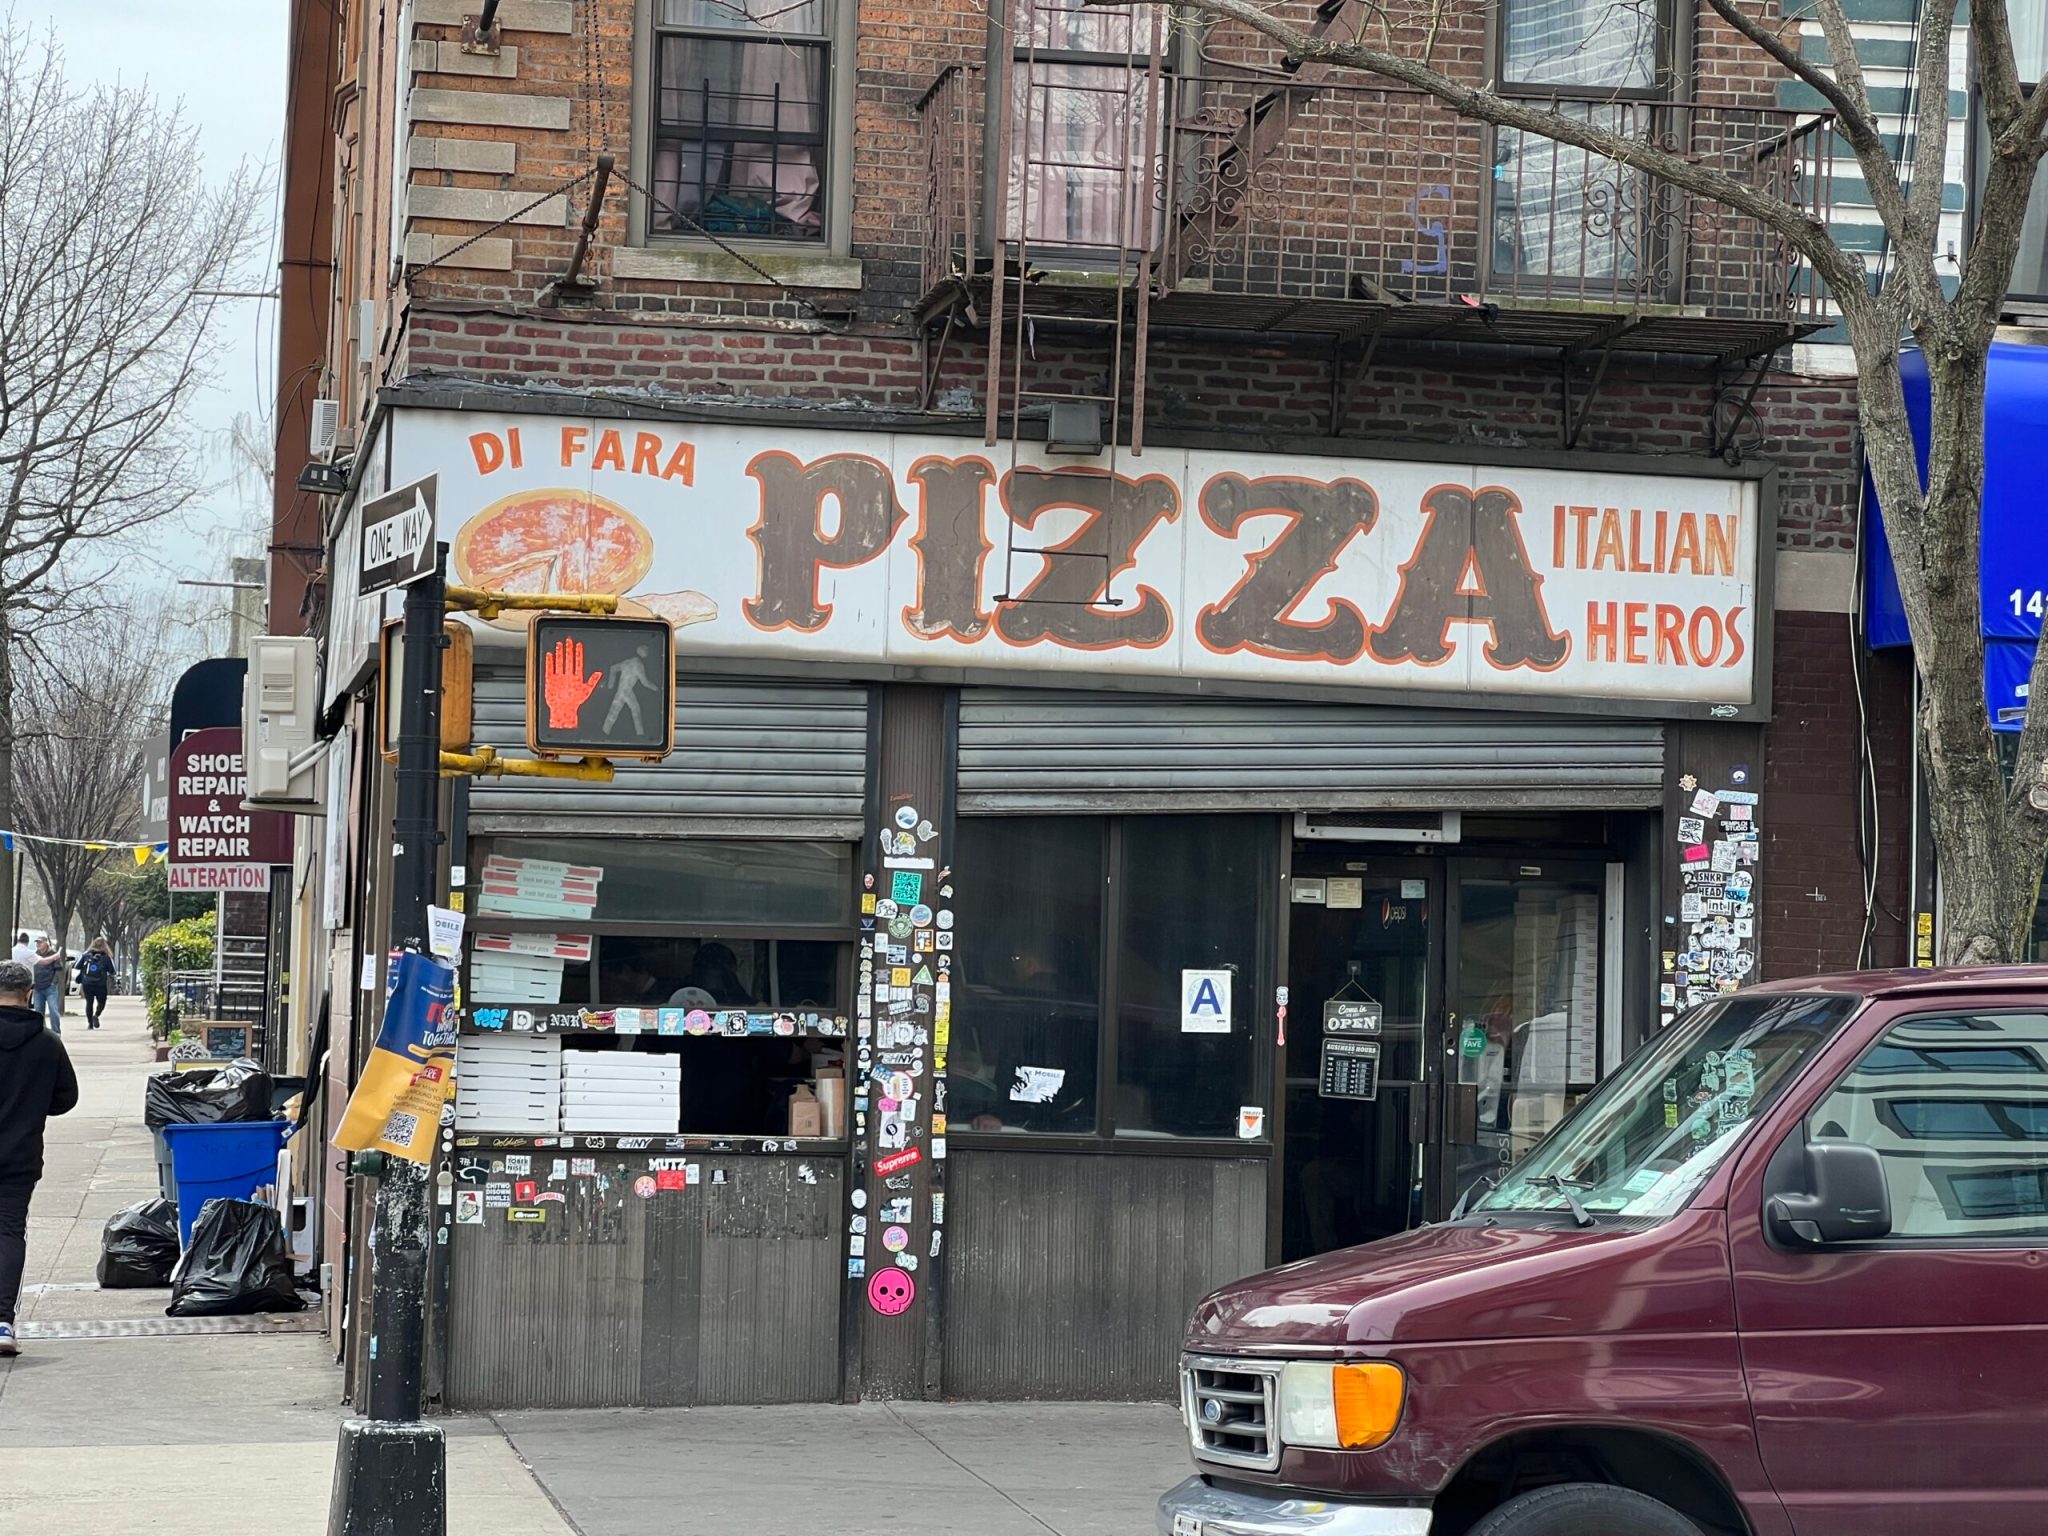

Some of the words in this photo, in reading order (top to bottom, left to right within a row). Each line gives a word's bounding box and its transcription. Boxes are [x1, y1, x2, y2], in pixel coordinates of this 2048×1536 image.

[468, 427, 522, 476] DI
[561, 426, 696, 488] FARA
[370, 523, 393, 564] ONE
[402, 508, 426, 553] WAY
[1552, 505, 1739, 578] ITALIAN
[742, 449, 1571, 673] PIZZA
[2009, 588, 2048, 618] 14
[1586, 601, 1747, 669] HEROS
[187, 754, 243, 773] SHOE
[178, 776, 249, 795] REPAIR
[208, 799, 221, 812] &
[179, 815, 250, 834] WATCH
[178, 838, 250, 857] REPAIR
[169, 867, 265, 888] ALTERATION
[1699, 872, 1722, 882] SNKR
[1698, 888, 1722, 897] HEAD
[1190, 978, 1222, 1014] A
[1338, 1004, 1358, 1014] Come
[1359, 1005, 1368, 1013] in
[1327, 1016, 1377, 1030] OPEN
[1326, 1043, 1355, 1052] BUSINESS
[648, 1158, 687, 1171] MUTZ
[877, 1151, 917, 1172] Supreme
